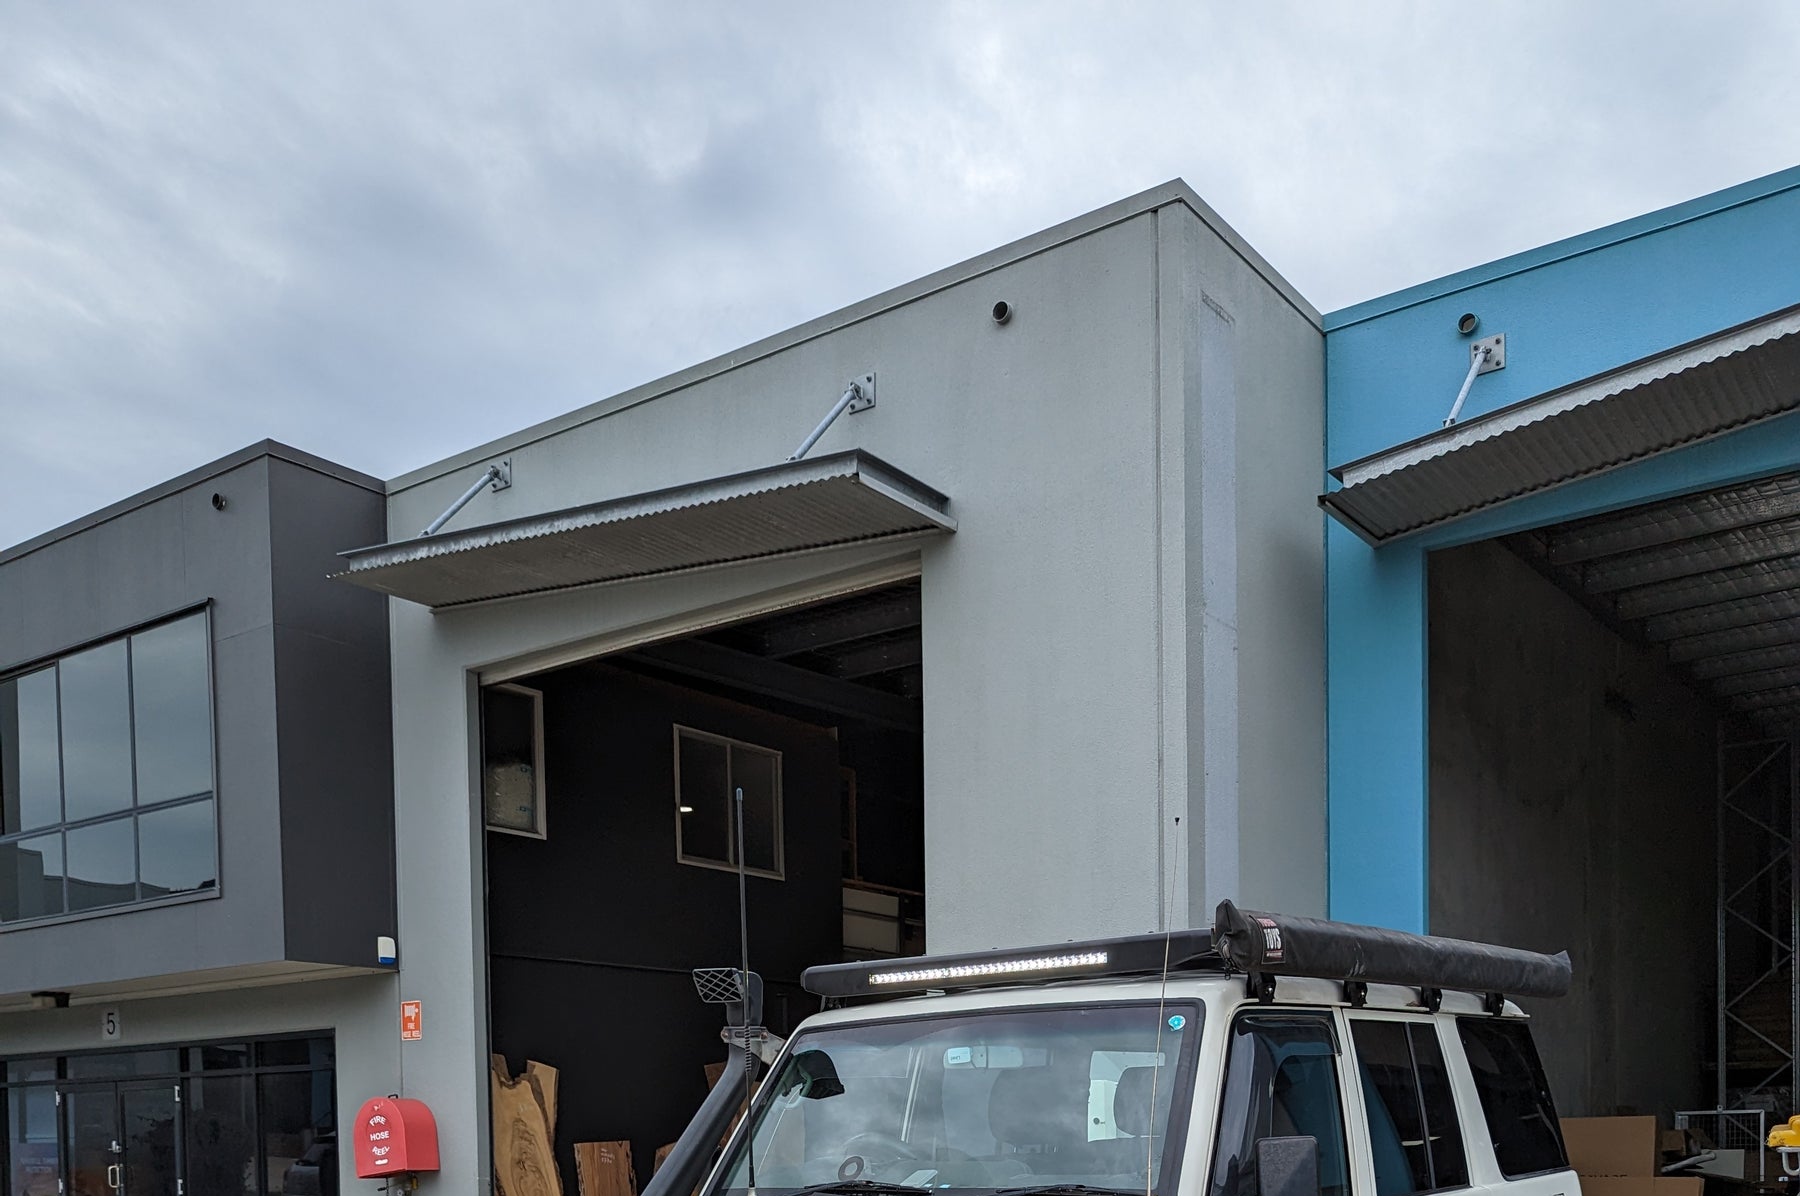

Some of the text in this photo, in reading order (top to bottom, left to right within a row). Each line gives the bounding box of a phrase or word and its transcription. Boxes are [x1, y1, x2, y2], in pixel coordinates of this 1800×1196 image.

[1263, 927, 1282, 949] TOYS
[107, 1012, 116, 1035] 5
[369, 1115, 387, 1126] FIRE
[369, 1130, 390, 1141] HOSE
[372, 1146, 390, 1156] REEL
